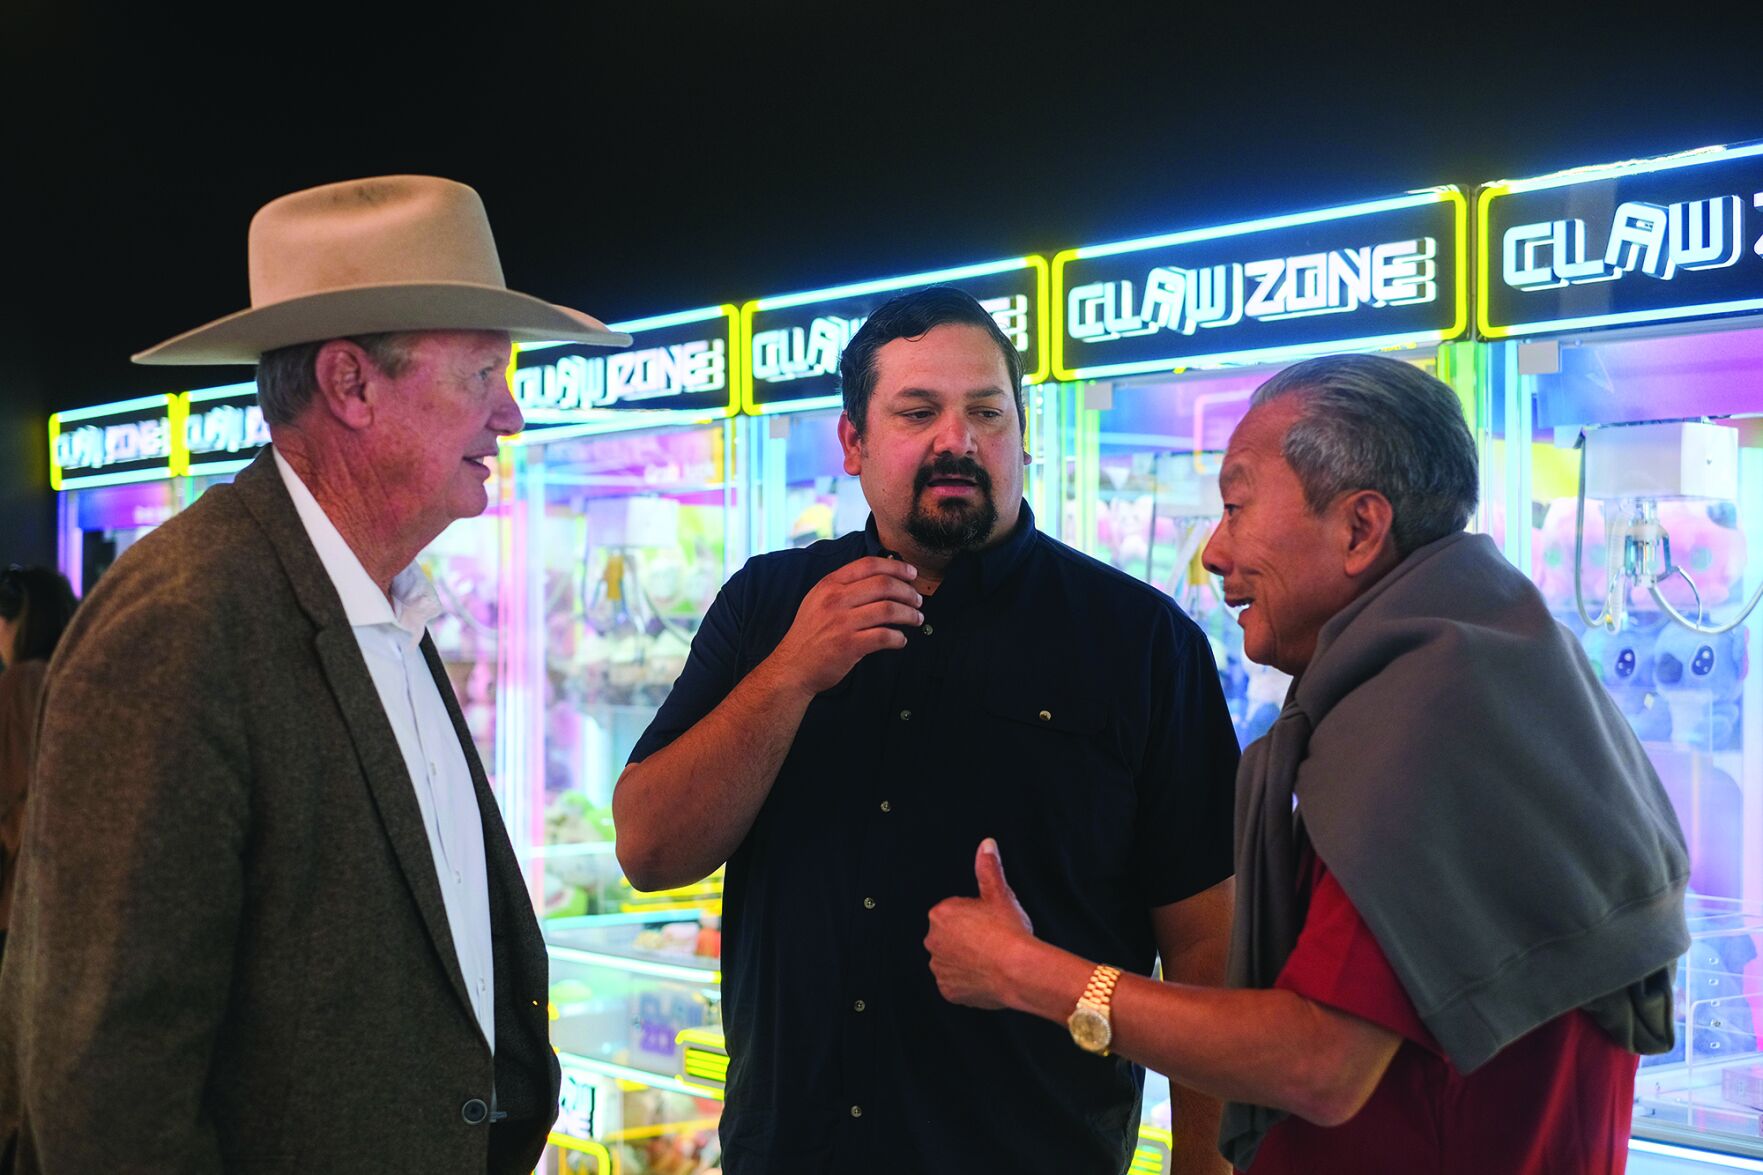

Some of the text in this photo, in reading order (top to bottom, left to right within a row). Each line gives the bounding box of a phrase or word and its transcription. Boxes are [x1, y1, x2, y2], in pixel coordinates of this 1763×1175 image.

[1068, 262, 1244, 343] CLAW
[1244, 237, 1437, 322] ZONE
[1503, 195, 1745, 292] CLAW
